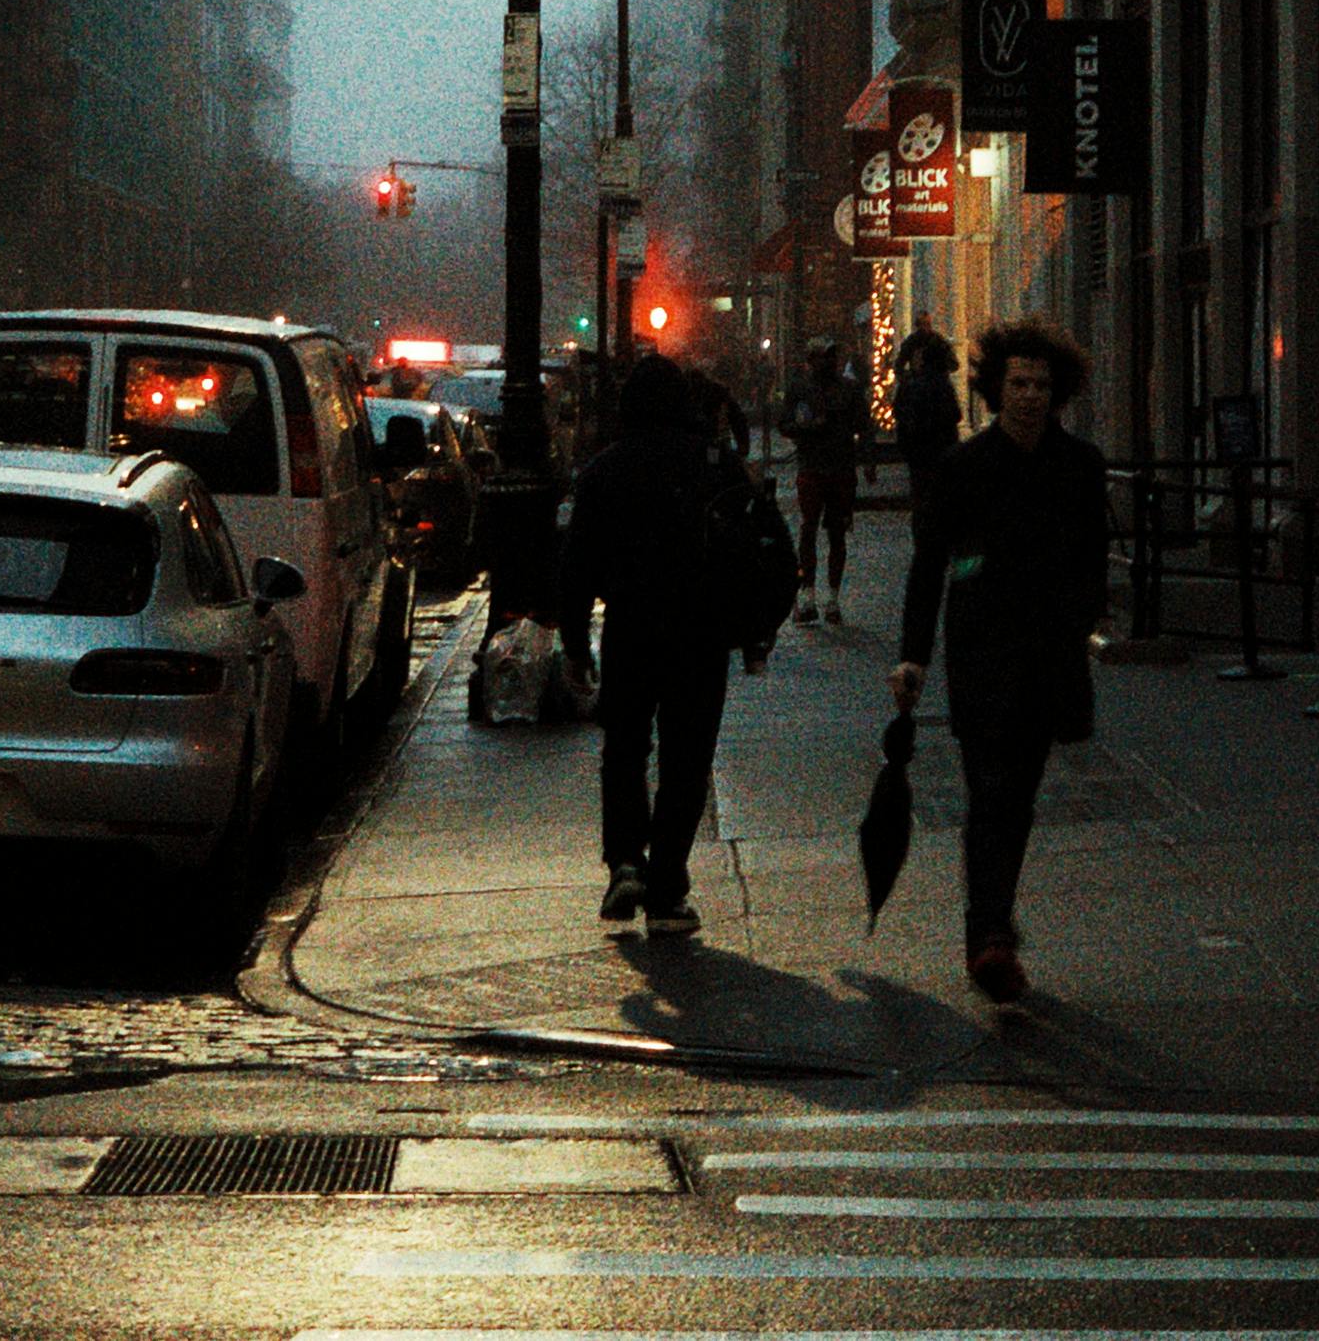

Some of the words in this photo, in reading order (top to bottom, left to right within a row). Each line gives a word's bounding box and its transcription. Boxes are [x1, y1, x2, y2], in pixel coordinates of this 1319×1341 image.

[1075, 34, 1099, 178] KNOTEL
[895, 168, 948, 188] BLICK
[914, 191, 930, 201] art
